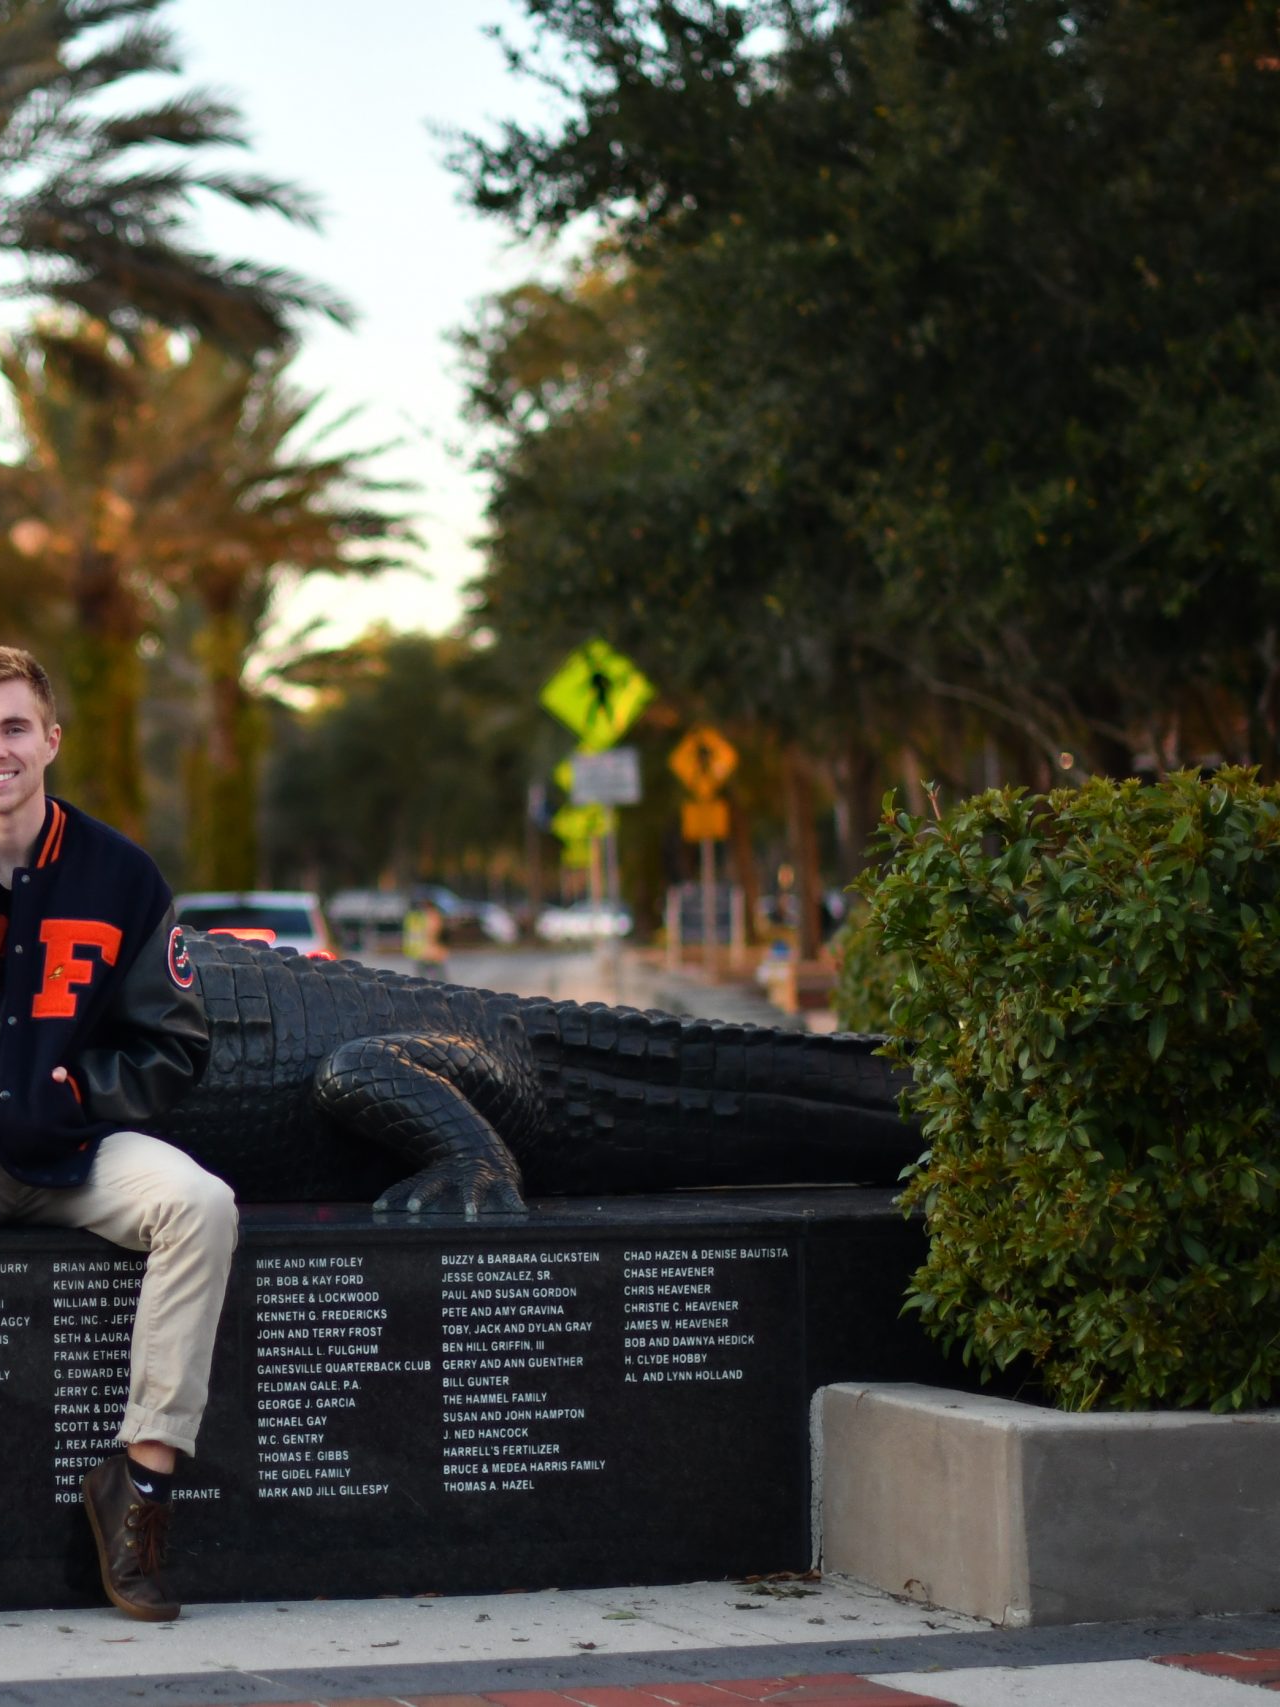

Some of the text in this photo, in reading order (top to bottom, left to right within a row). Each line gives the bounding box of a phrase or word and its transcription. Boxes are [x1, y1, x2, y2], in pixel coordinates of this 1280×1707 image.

[32, 919, 123, 1017] F
[624, 1246, 789, 1261] CHAD HAZEN & DENISE BAUTISTA
[257, 1256, 364, 1269] MIKE AND KIM FOLEY
[624, 1265, 715, 1278] CHASE HEAVENER
[442, 1285, 577, 1300] PAUL AND SUSAN GORDON
[624, 1283, 711, 1296] CHRIS HEAVENER
[257, 1291, 380, 1304] FORSHEE & LOCKWOOD
[54, 1331, 131, 1344] SETH & LAURA
[258, 1325, 383, 1340] JOHN AND TERRY FROST
[625, 1334, 755, 1348] BOB AND DAWNYA HEDICK
[258, 1359, 432, 1375] GAINESVILLE QUARTERBACK CLUB
[443, 1355, 584, 1370] GERRY AND ANN GUENTHER
[443, 1374, 510, 1388] BILL GUNTER
[443, 1391, 547, 1405] THE HAMMEL FAMILY
[258, 1414, 328, 1428] MICHAEL GAY
[444, 1443, 560, 1458] HARRELL'S FERTILIZER
[259, 1467, 351, 1481] THE GIDEL FAMILY
